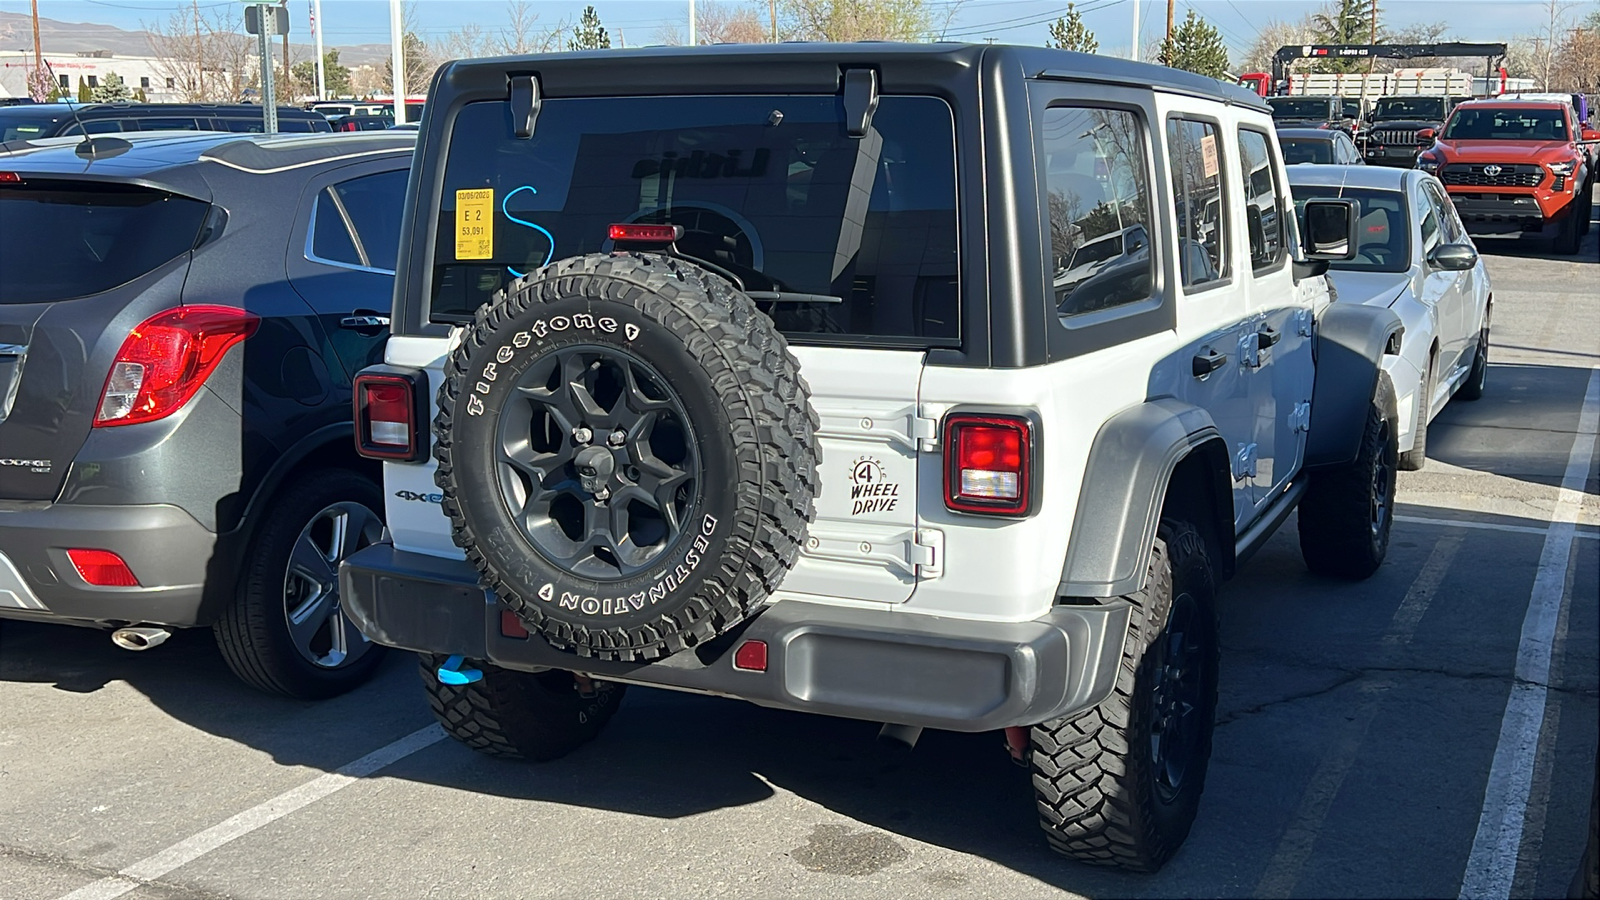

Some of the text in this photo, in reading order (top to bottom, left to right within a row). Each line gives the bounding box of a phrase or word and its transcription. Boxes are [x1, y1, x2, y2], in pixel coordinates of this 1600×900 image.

[464, 209, 482, 222] E 2
[461, 226, 485, 236] 53,091
[466, 313, 618, 417] Firestone
[857, 464, 873, 483] 4
[851, 483, 899, 499] WHEEL
[852, 498, 898, 515] DRIVE
[558, 513, 719, 616] DESTINATION
